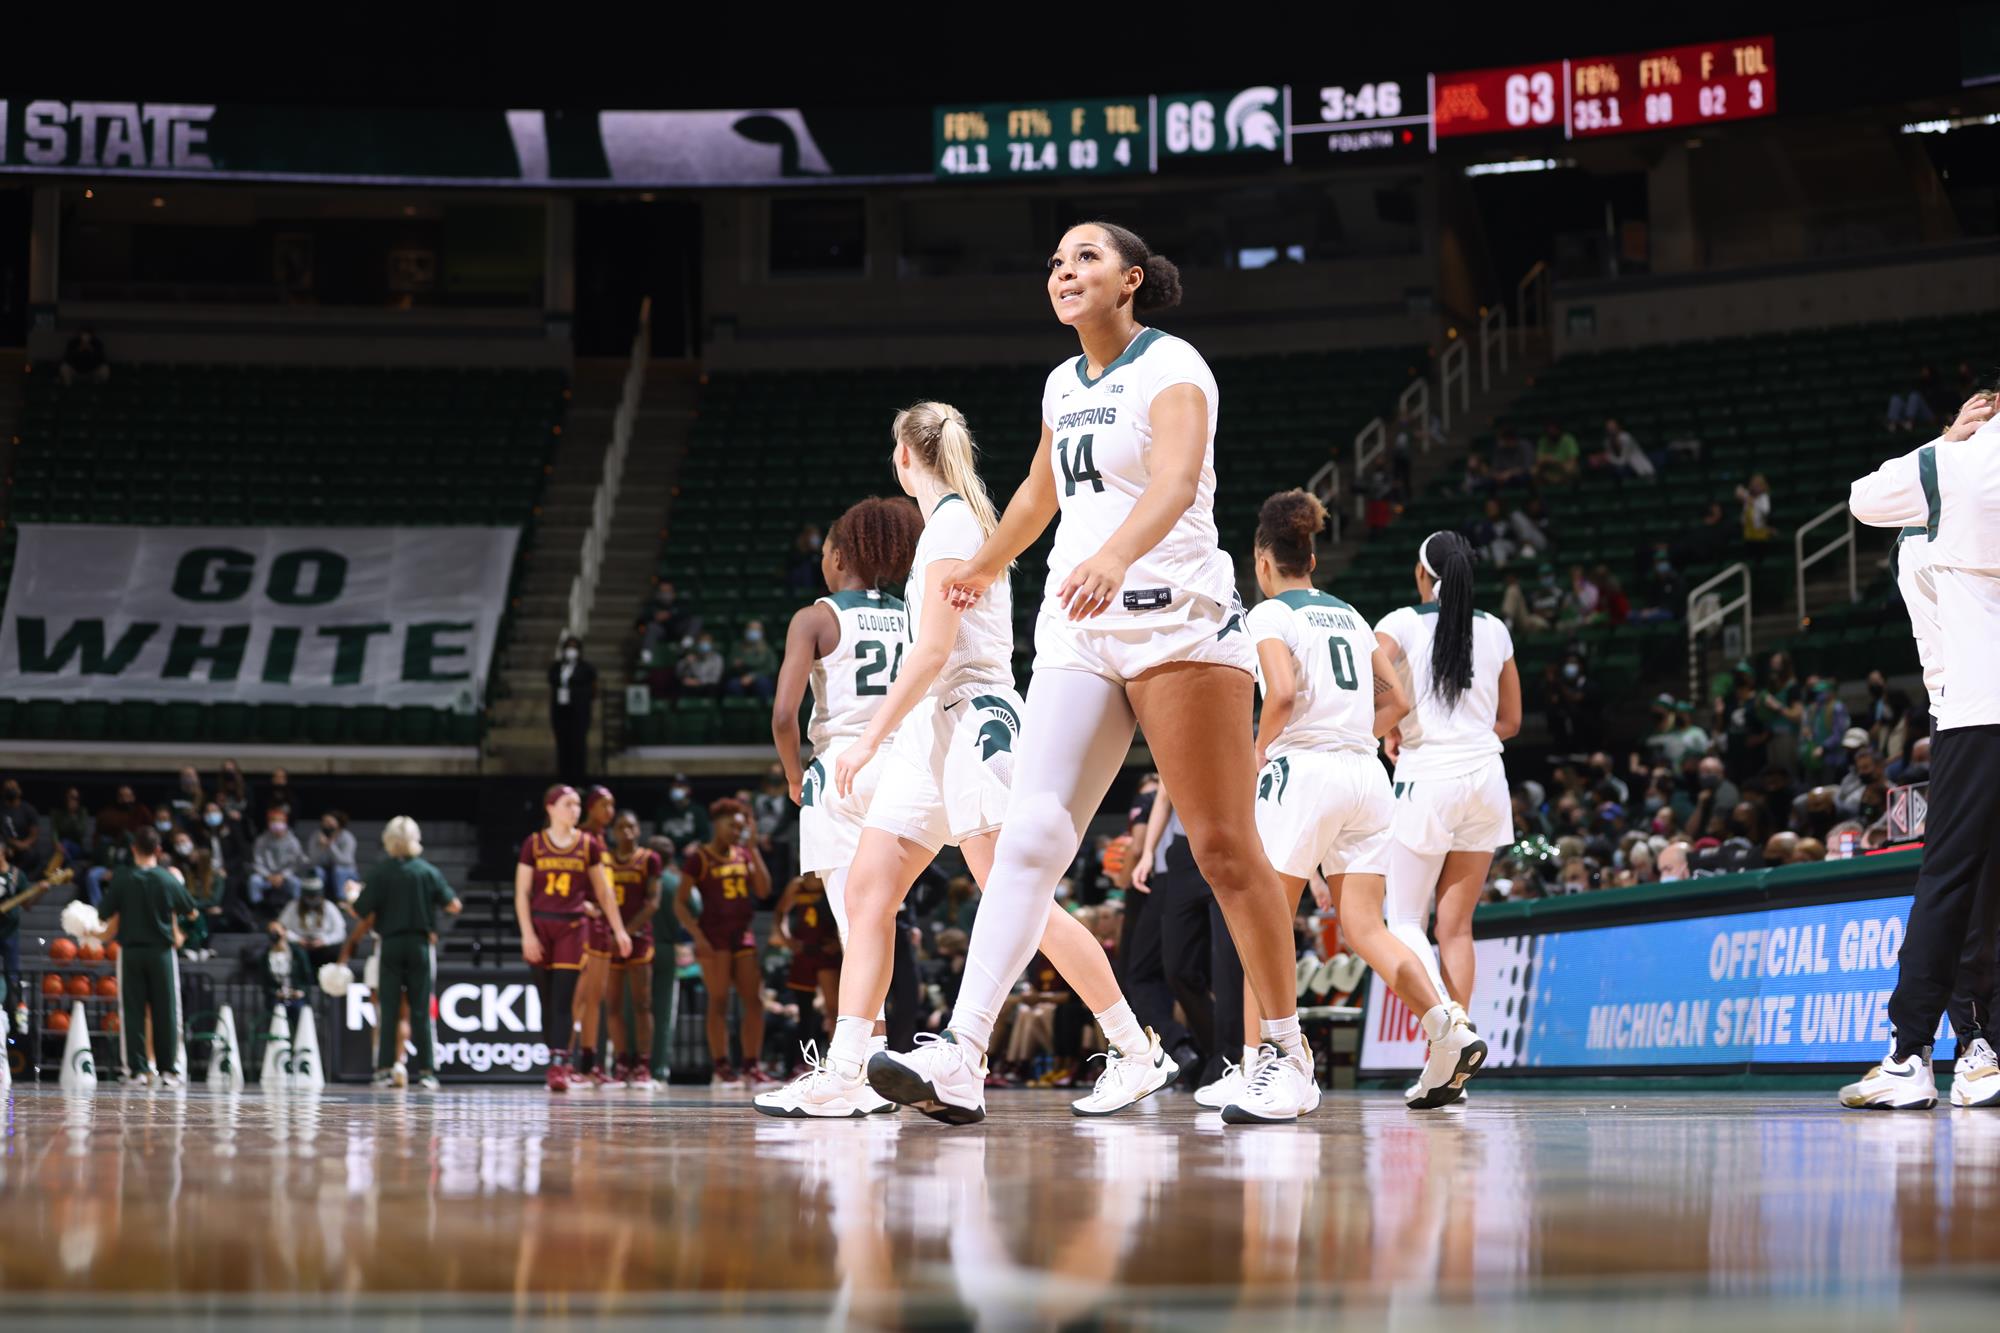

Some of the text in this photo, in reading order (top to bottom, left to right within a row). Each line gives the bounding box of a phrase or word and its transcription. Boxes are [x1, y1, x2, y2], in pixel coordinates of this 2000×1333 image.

[1639, 56, 1682, 89] FT%
[1701, 52, 1714, 81] F
[1733, 45, 1768, 77] TOL
[1071, 107, 1085, 136] F
[1320, 82, 1401, 122] 3:46
[1505, 72, 1555, 126] 63
[1573, 97, 1622, 130] 35.1
[1699, 85, 1726, 116] 02
[1748, 79, 1763, 109] 3
[24, 99, 216, 168] STATE
[1165, 101, 1215, 153] 66
[1328, 131, 1394, 151] FOURTH
[941, 144, 990, 174] 41.1
[1008, 141, 1058, 171] 71.4
[1113, 137, 1131, 167] 4
[1056, 407, 1117, 432] SPARTANS
[1057, 434, 1105, 497] 14
[171, 547, 349, 606] GO
[858, 614, 904, 633] CLOUDEN
[1304, 611, 1356, 630] HAGEMANN
[16, 615, 475, 685] WHITE
[1328, 636, 1358, 690] 0
[544, 872, 571, 896] 14
[1709, 915, 1906, 982] OFFICIAL GRO
[1586, 999, 1711, 1049] MICHIGAN
[1713, 995, 1796, 1047] STATE
